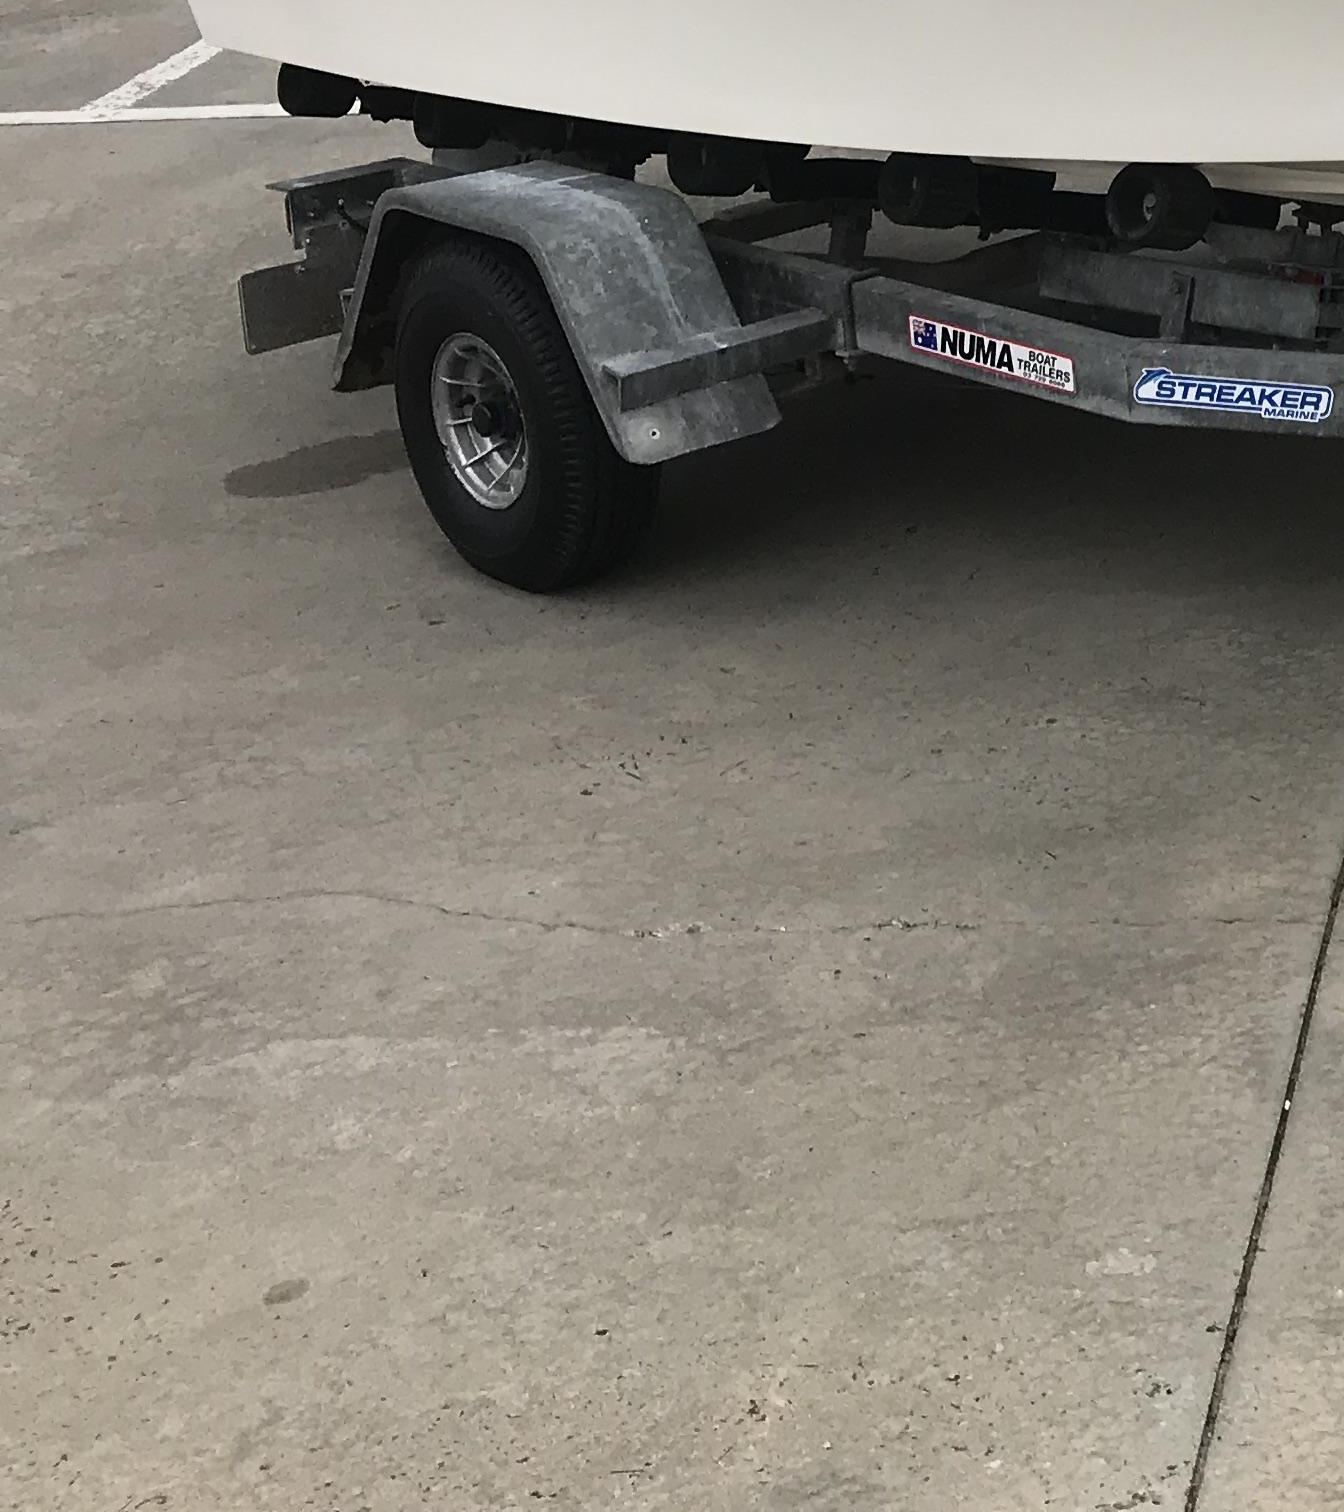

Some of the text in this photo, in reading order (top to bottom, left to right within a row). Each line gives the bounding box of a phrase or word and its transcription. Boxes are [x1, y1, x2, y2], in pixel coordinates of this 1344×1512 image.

[940, 326, 1015, 372] NUMA
[1028, 350, 1057, 367] BOAT
[1017, 358, 1071, 383] TRAILERS
[1156, 380, 1322, 411] STREAKER
[1263, 408, 1319, 420] MARINE
